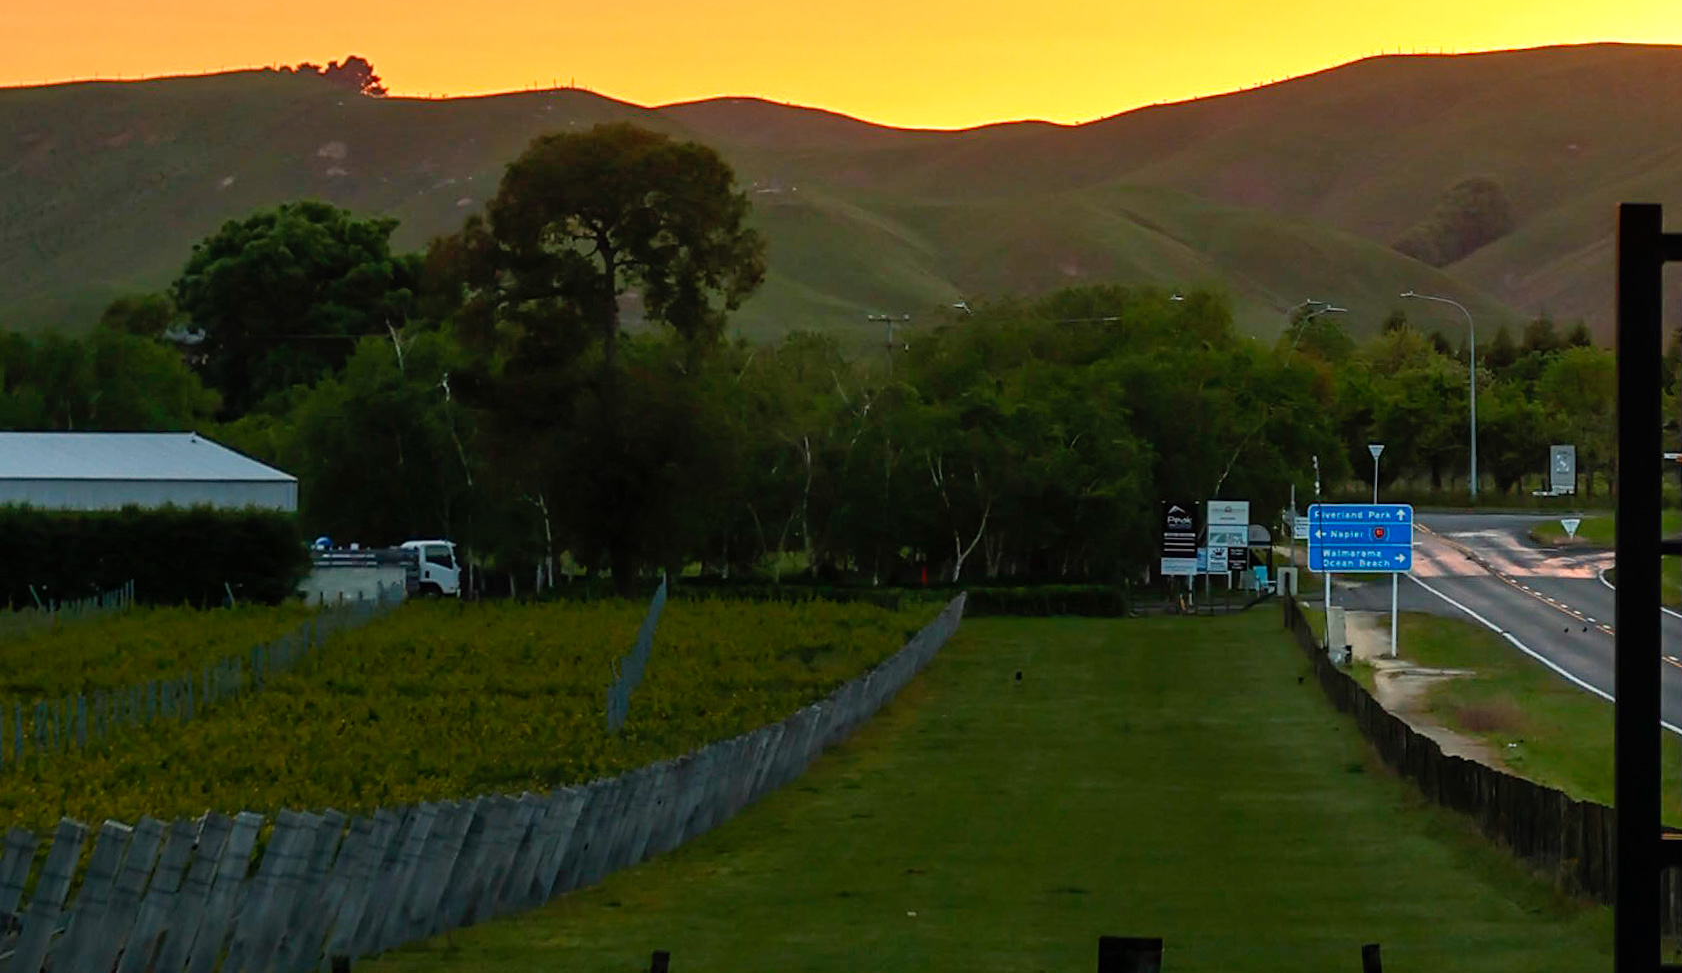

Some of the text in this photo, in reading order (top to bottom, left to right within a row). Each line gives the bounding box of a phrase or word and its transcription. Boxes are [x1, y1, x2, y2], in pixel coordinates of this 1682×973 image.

[1368, 510, 1391, 519] Park
[1330, 530, 1363, 539] Napier
[1322, 549, 1381, 558] Waimarama
[1322, 559, 1390, 568] Ocean Beach
